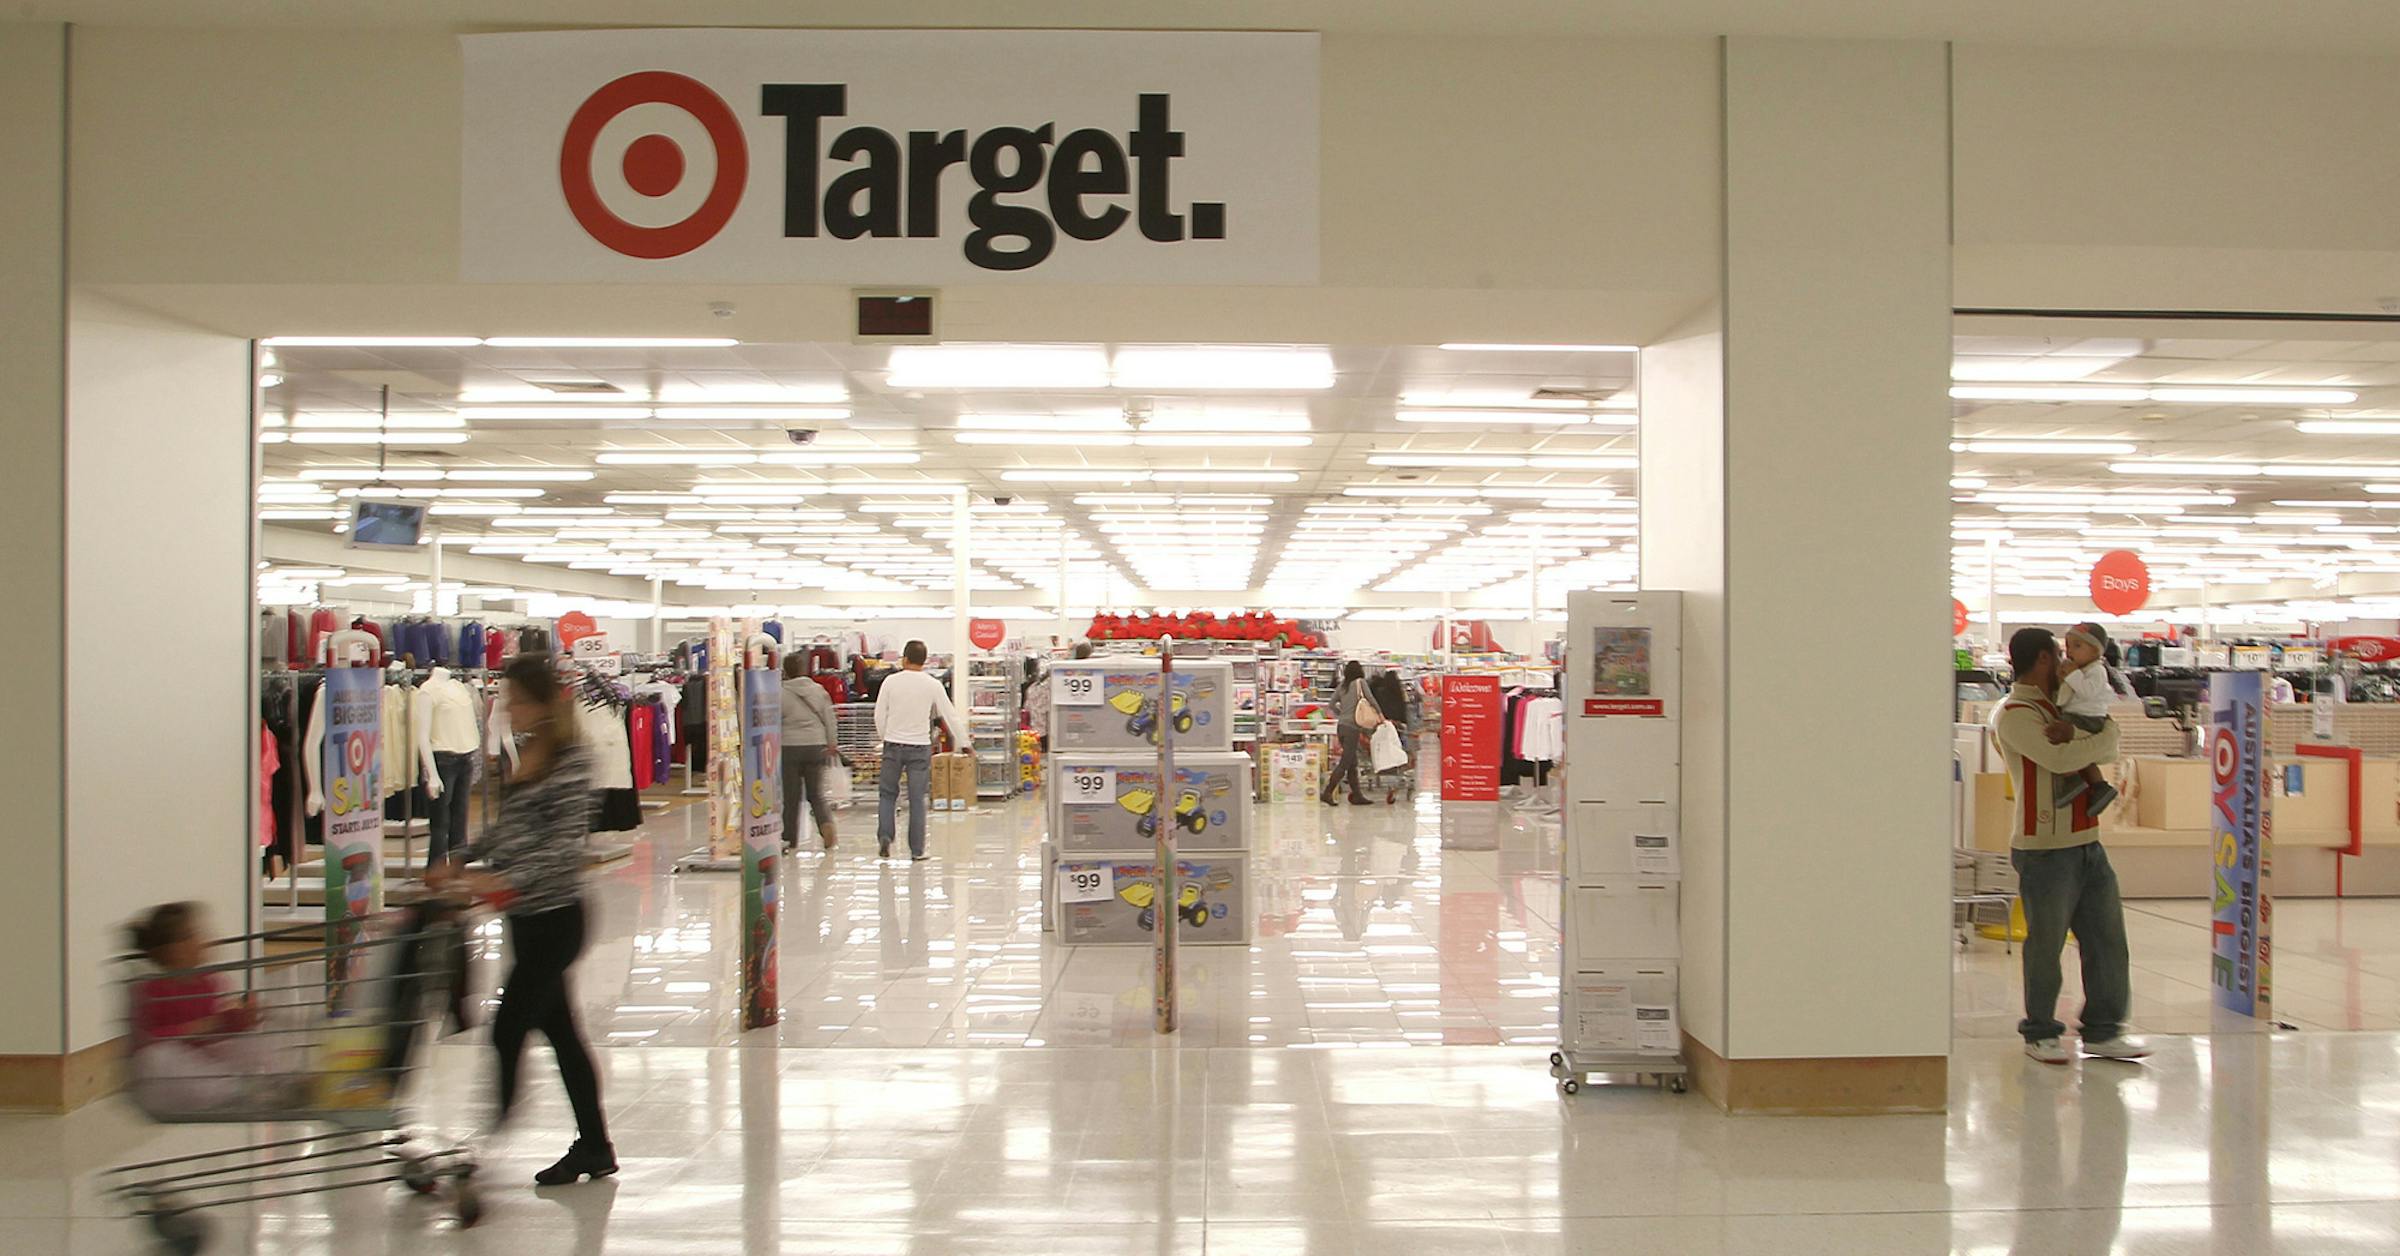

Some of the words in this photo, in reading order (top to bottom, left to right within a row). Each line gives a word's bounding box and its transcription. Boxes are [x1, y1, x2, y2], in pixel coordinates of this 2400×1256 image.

[2102, 574, 2140, 592] Boys
[1063, 678, 1092, 692] $99
[332, 729, 378, 778] TOY
[2213, 699, 2240, 826] TOY
[1073, 775, 1104, 790] $99
[2241, 701, 2257, 871] AUSTRALIA'S
[1070, 873, 1100, 888] $99
[2211, 826, 2238, 992] SALE
[2239, 881, 2253, 998] BIGGEST
